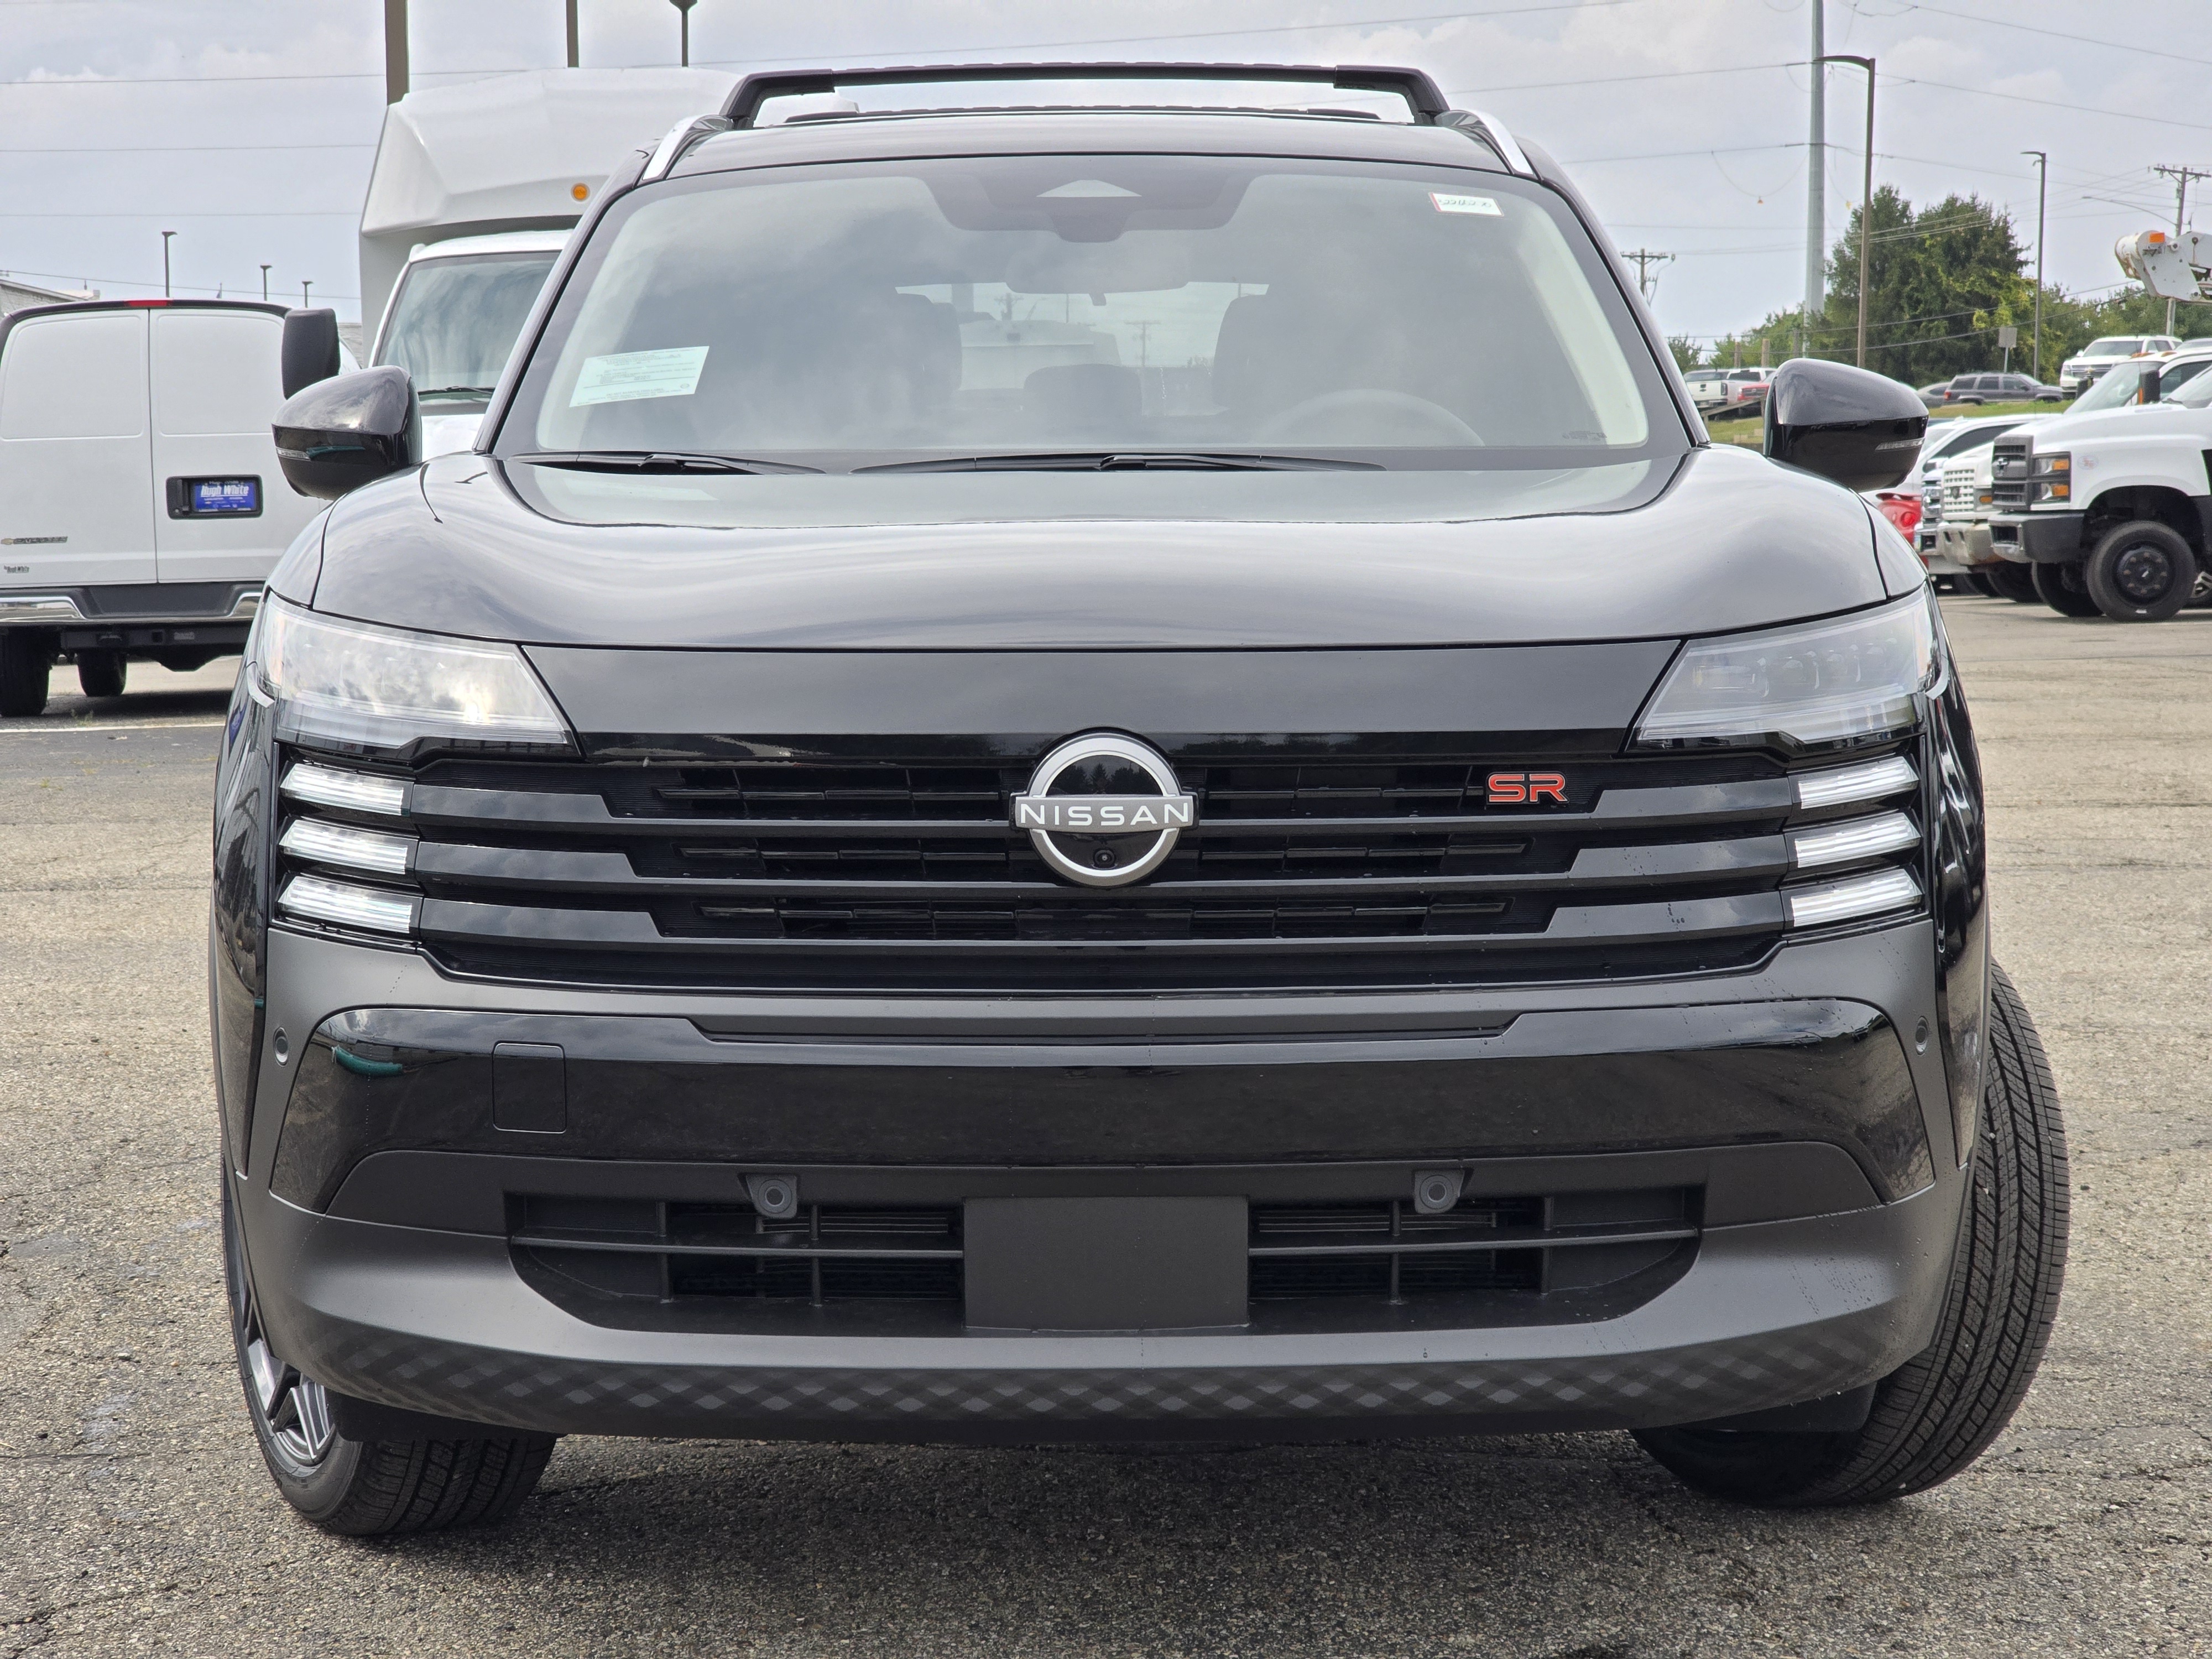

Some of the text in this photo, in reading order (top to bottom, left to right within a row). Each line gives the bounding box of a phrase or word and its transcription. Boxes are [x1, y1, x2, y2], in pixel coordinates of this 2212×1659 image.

[223, 484, 249, 496] White
[1488, 774, 1568, 802] SR
[1021, 802, 1188, 826] NISSAN
